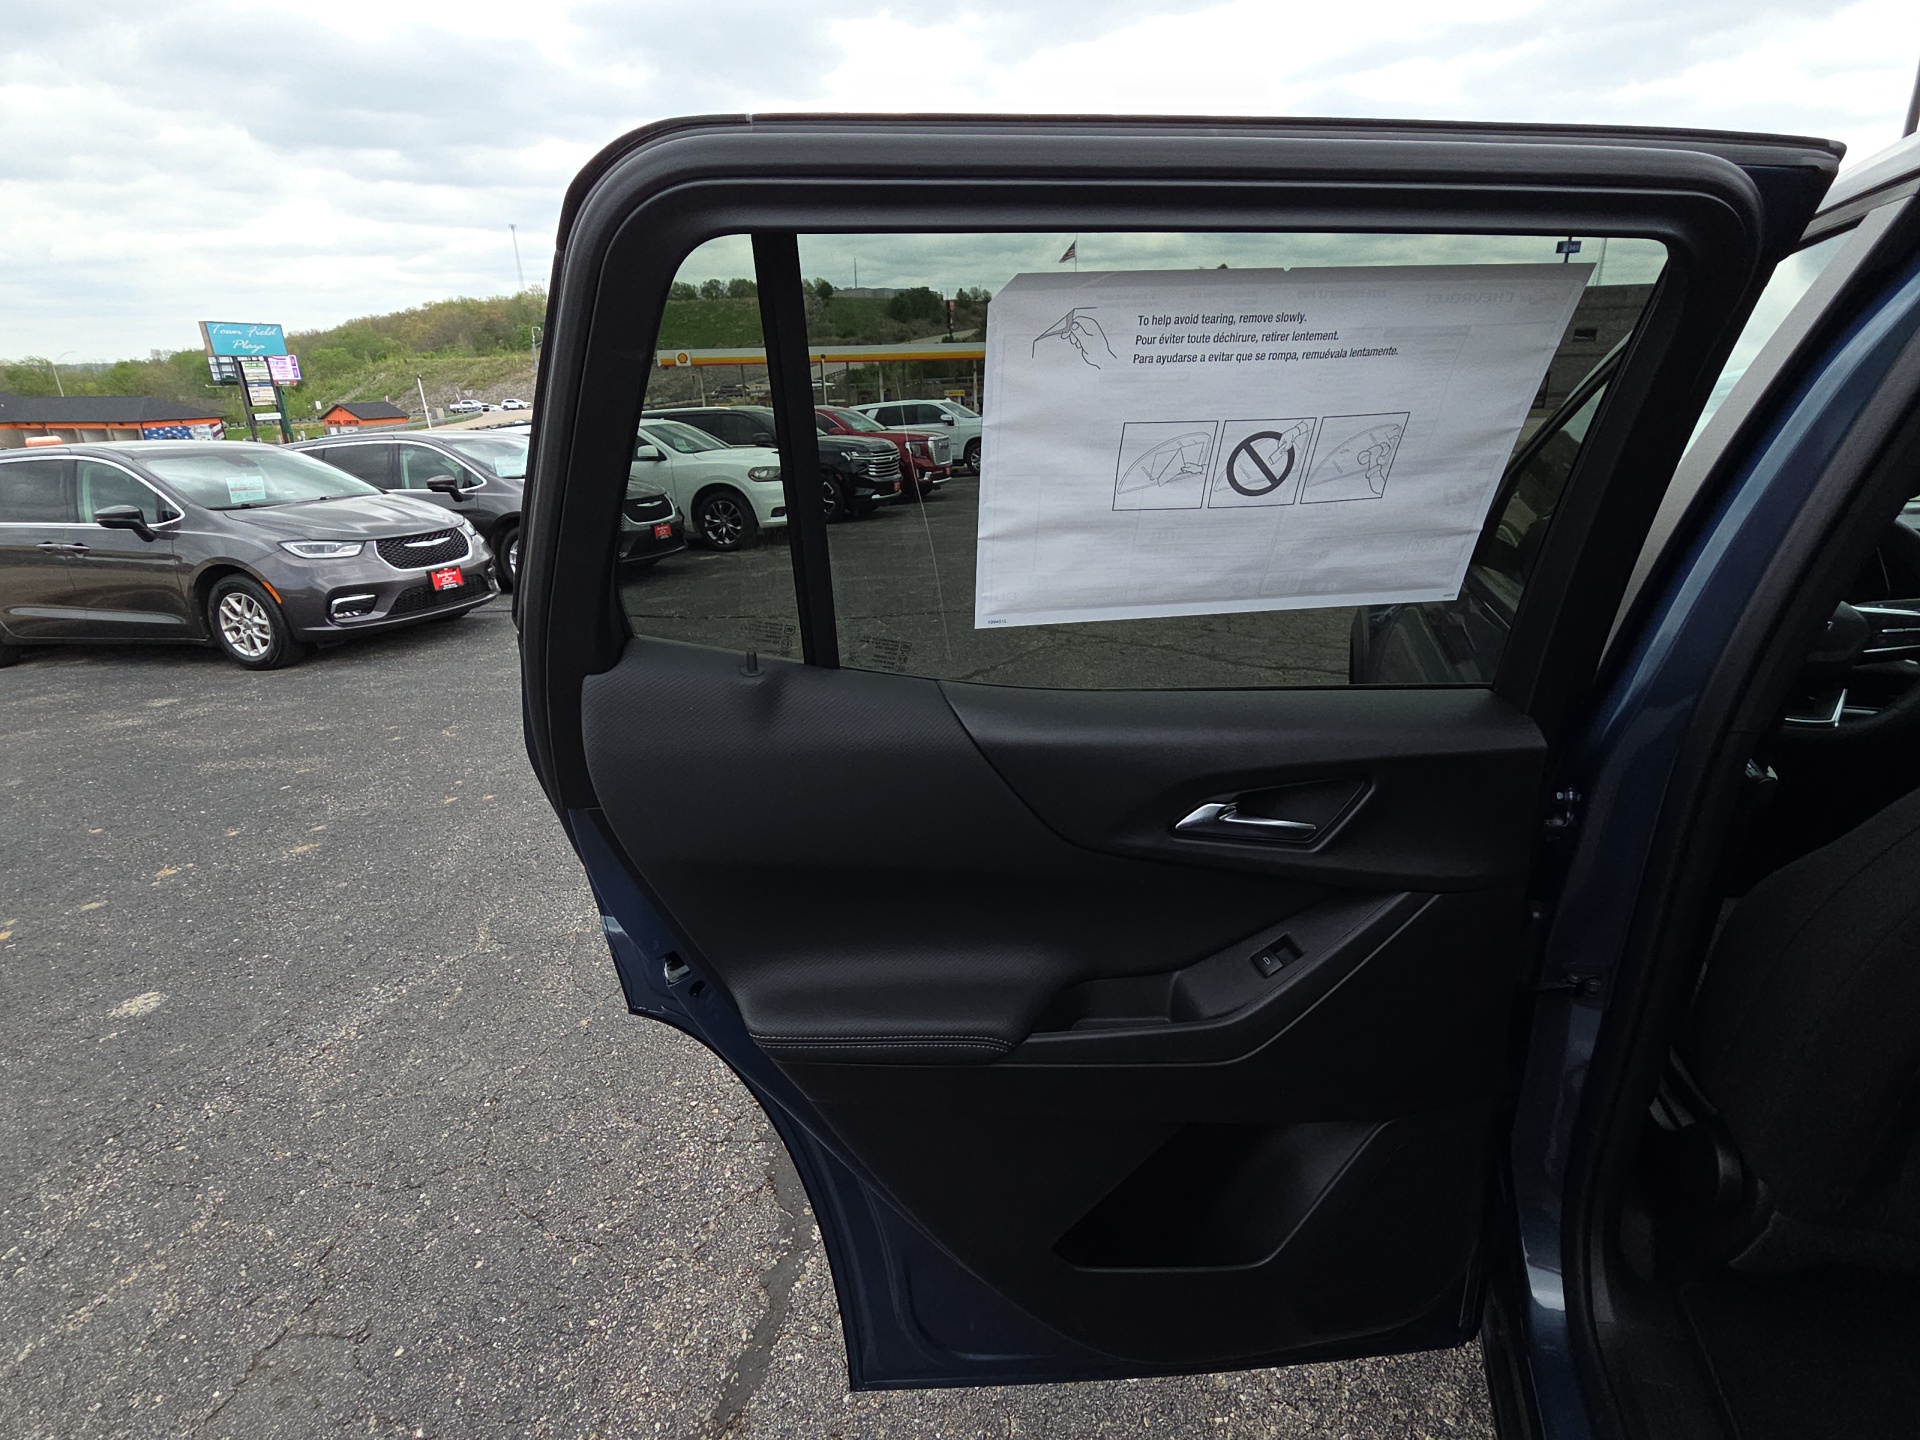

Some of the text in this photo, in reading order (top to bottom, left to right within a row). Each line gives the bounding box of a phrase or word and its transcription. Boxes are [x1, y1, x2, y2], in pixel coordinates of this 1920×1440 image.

[1138, 311, 1308, 328] To help avoid tearing, remove slowly.
[212, 324, 277, 337] Town Field
[1135, 330, 1340, 346] Pour éviter toute déchirure, retirer lentement.
[1133, 345, 1399, 366] Para ayudarse a evitar que se rompa, remuévala lentamente.
